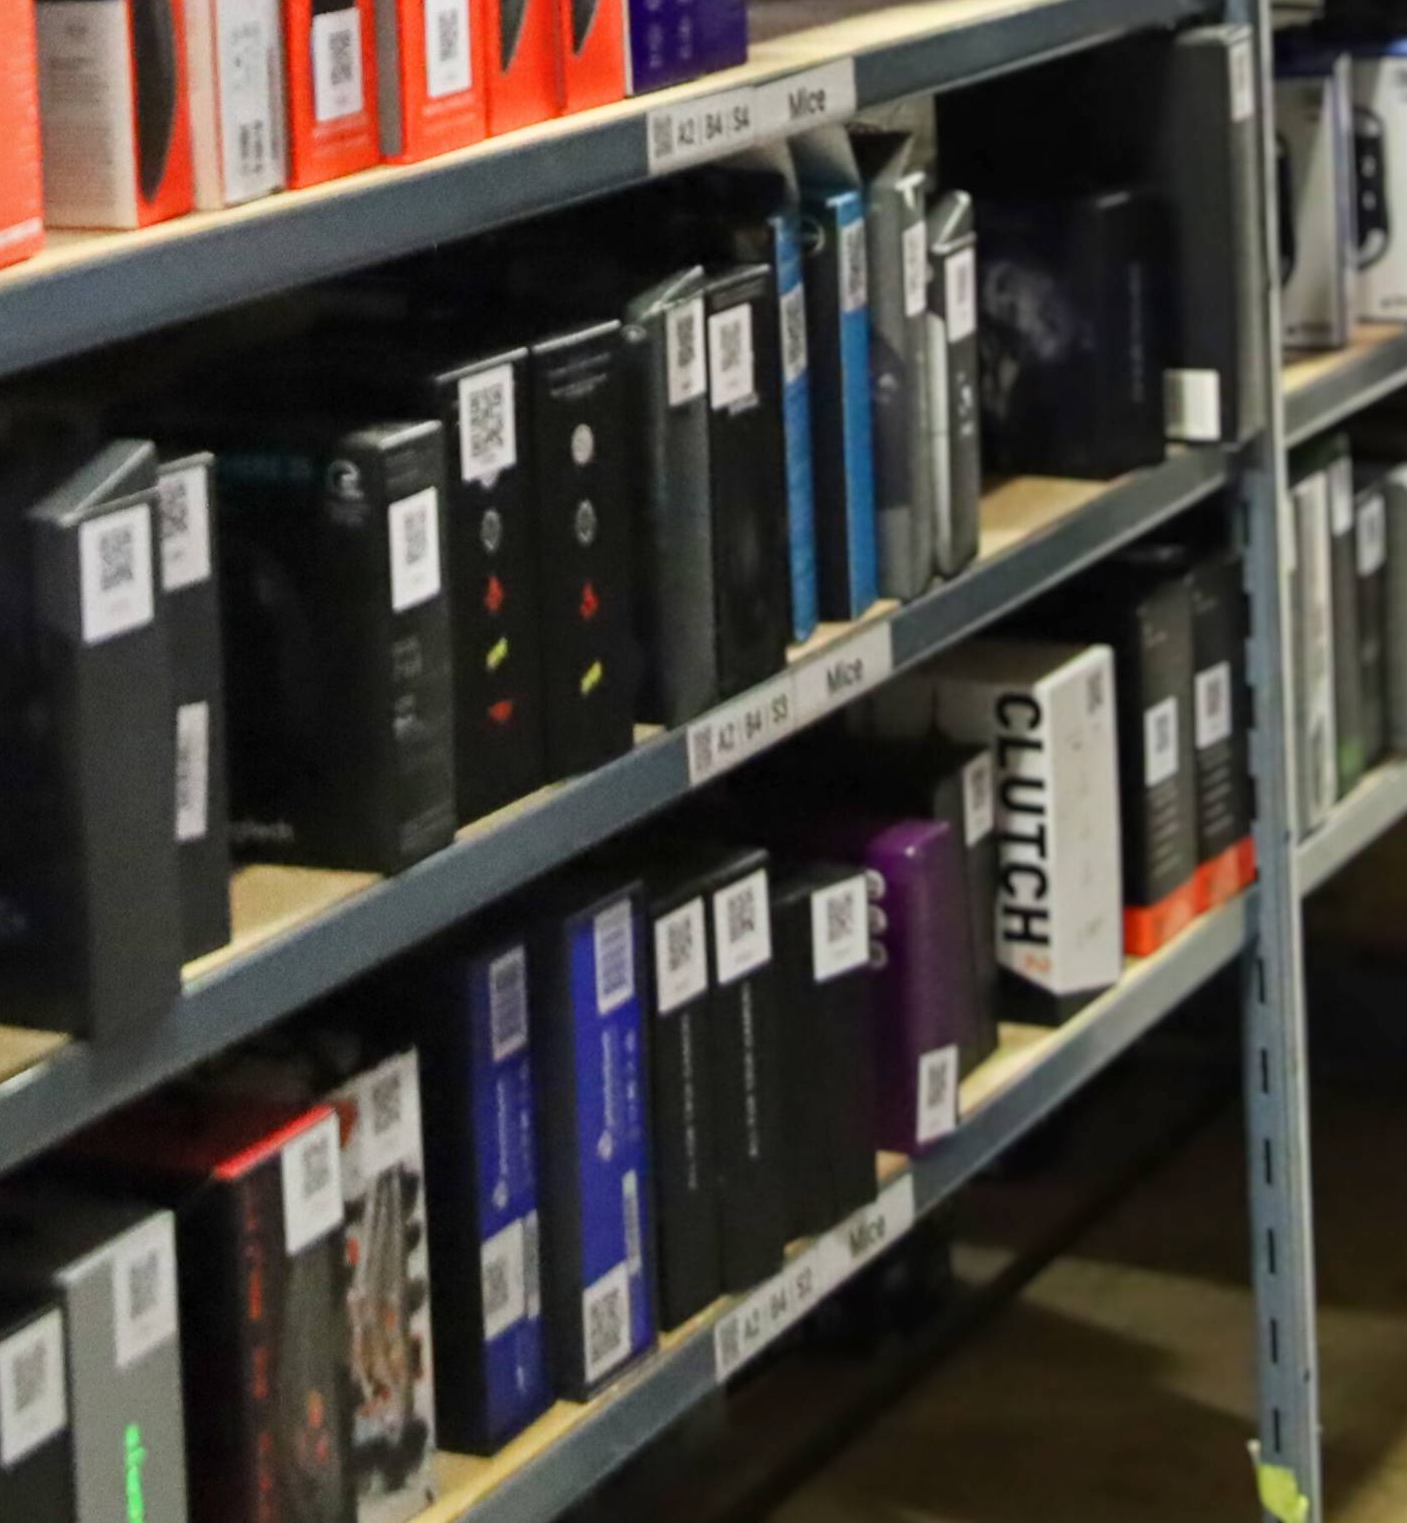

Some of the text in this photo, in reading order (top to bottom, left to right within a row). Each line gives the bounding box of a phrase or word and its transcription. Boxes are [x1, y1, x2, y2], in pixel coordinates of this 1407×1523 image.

[676, 104, 750, 145] A2 B4 S4
[788, 87, 826, 120] Mice
[826, 657, 863, 693] Mice
[717, 692, 788, 752] A2 B4 S3
[996, 693, 1050, 946] CLUTCH
[849, 1213, 886, 1258] Mice
